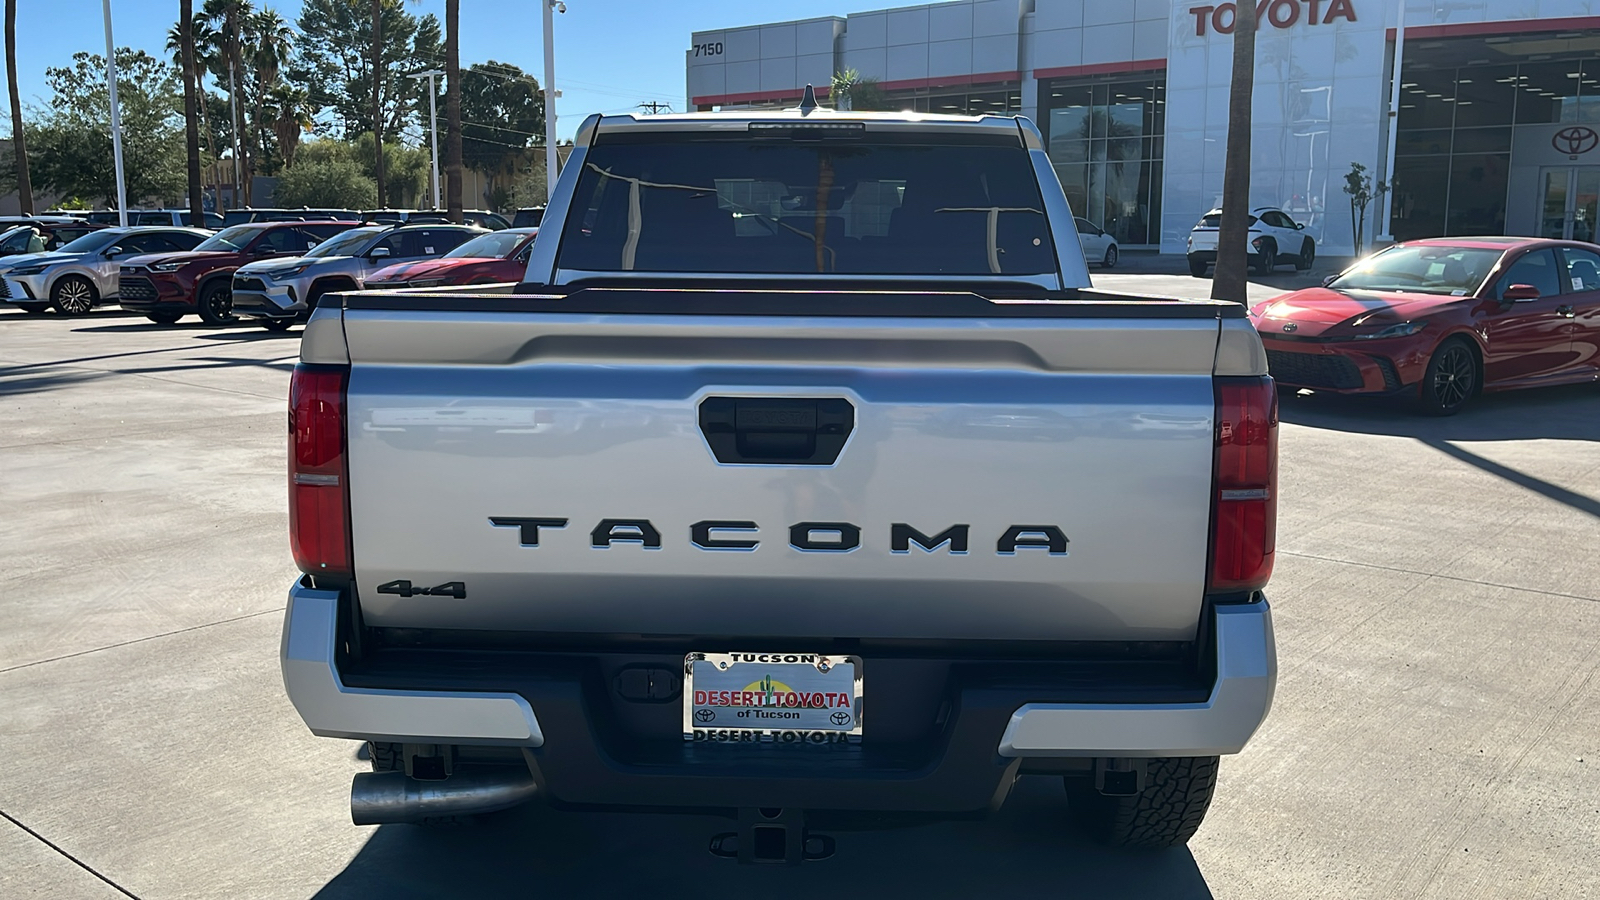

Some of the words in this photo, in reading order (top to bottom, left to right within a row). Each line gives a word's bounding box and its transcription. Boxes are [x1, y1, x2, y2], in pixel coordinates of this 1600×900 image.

[693, 42, 723, 57] 7150
[488, 516, 1070, 556] TACOMA
[730, 653, 815, 663] TUCSON
[694, 690, 766, 707] DESERT
[773, 691, 850, 708] TOYOTA
[737, 709, 751, 718] of
[753, 709, 800, 719] Tucson
[693, 730, 763, 742] DESERT
[771, 731, 849, 743] TOYOTA
